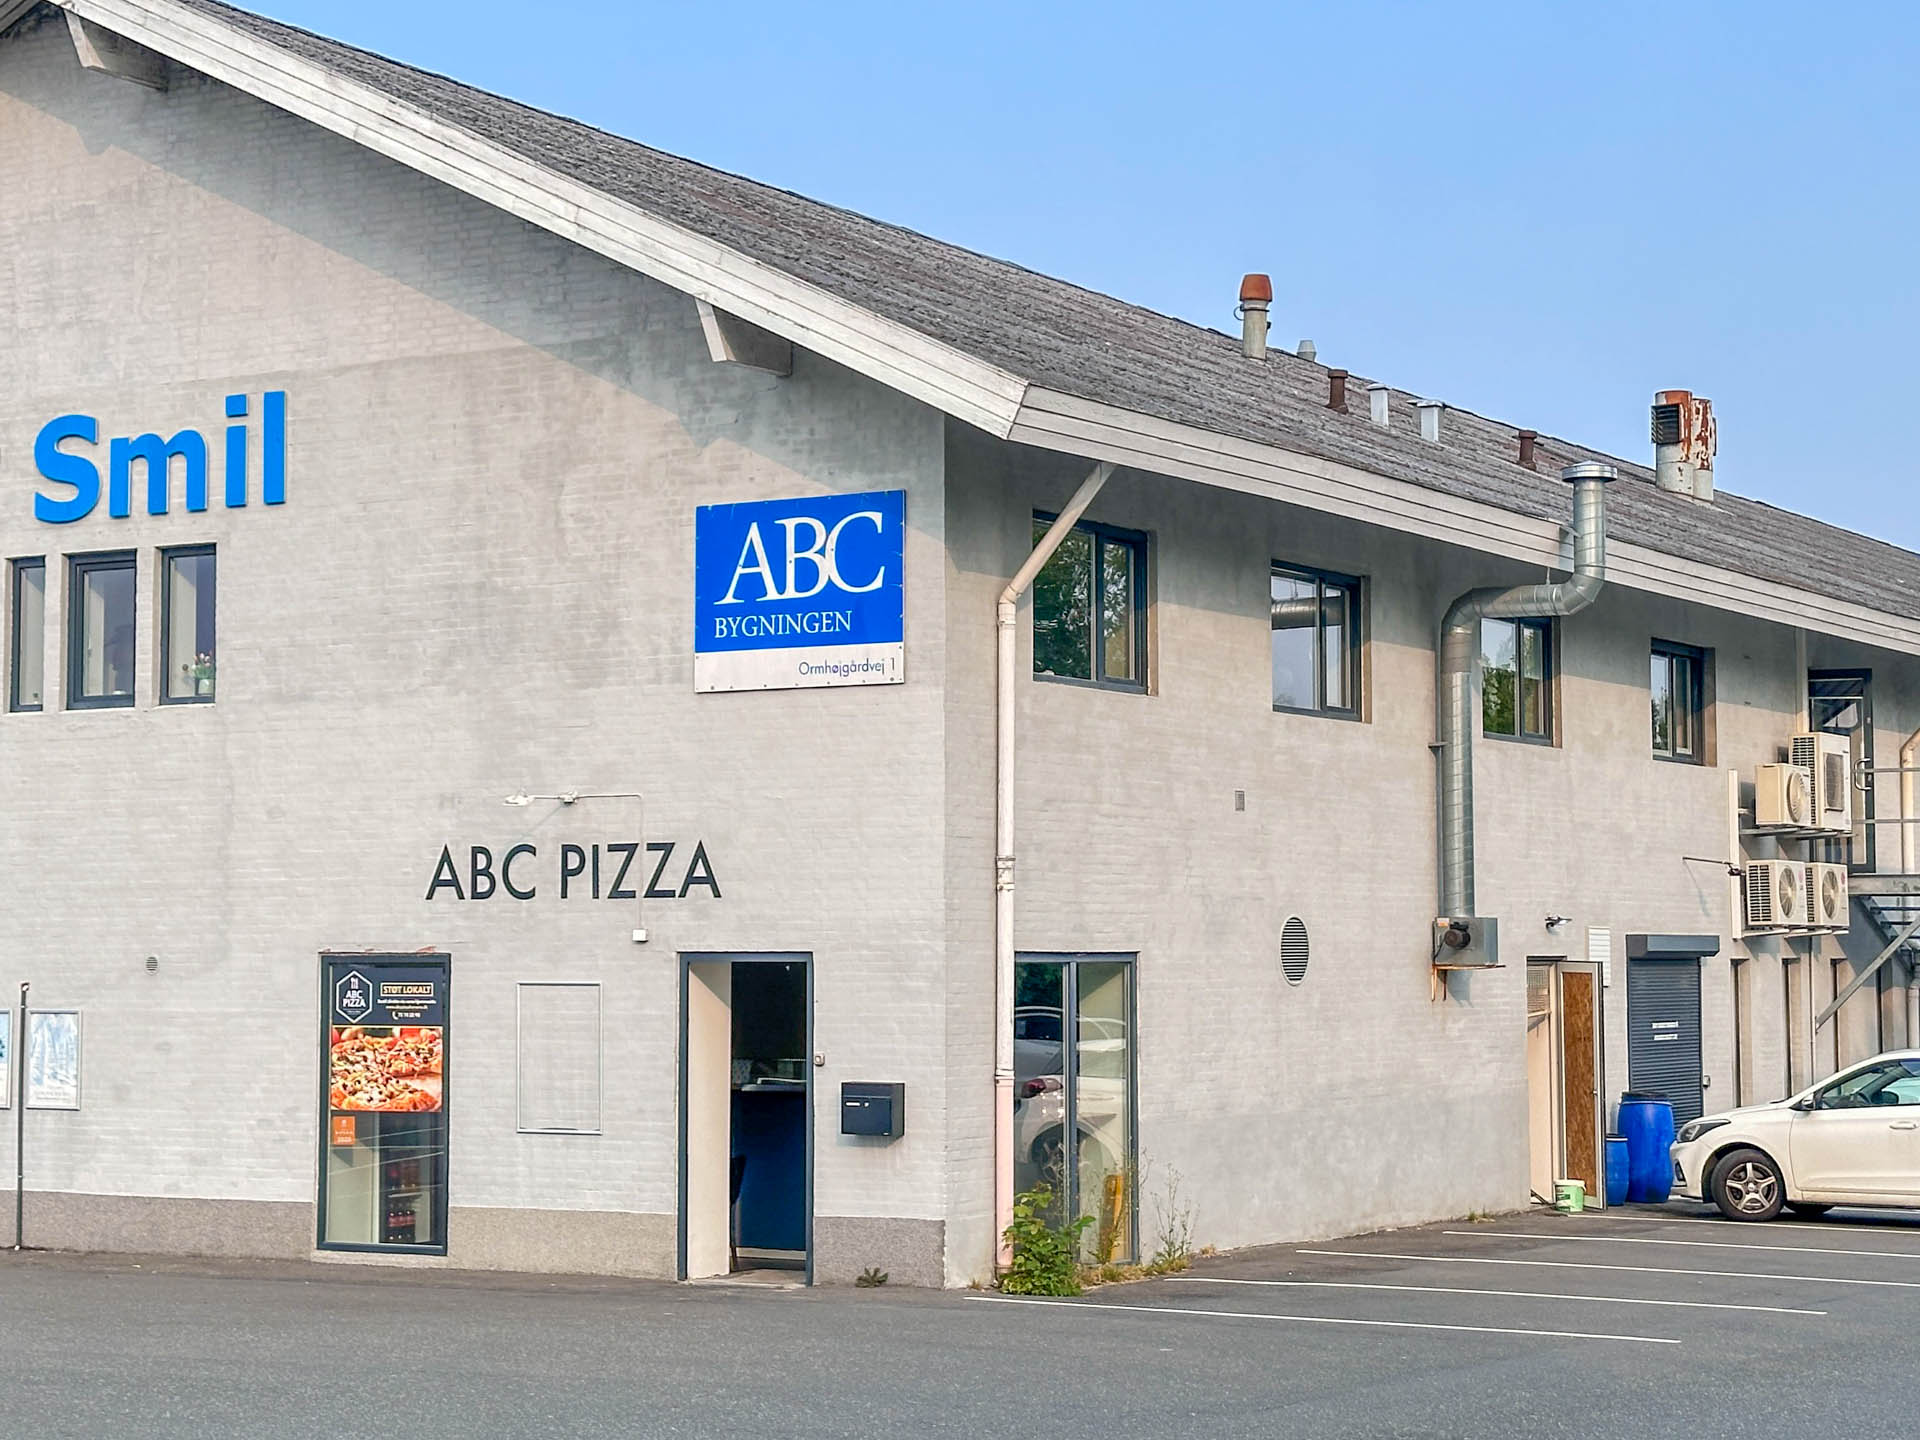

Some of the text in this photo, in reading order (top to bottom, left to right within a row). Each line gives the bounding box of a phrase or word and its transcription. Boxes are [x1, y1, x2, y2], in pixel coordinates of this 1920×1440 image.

[34, 390, 288, 524] Smil
[713, 511, 885, 605] ABC
[714, 610, 852, 639] BYGNINGEN
[799, 657, 895, 678] Ormhøjgårdvej 1
[425, 839, 722, 900] ABC PIZZA
[345, 990, 363, 999] ABC
[403, 985, 431, 994] LOKALT
[342, 998, 366, 1008] PIZZA
